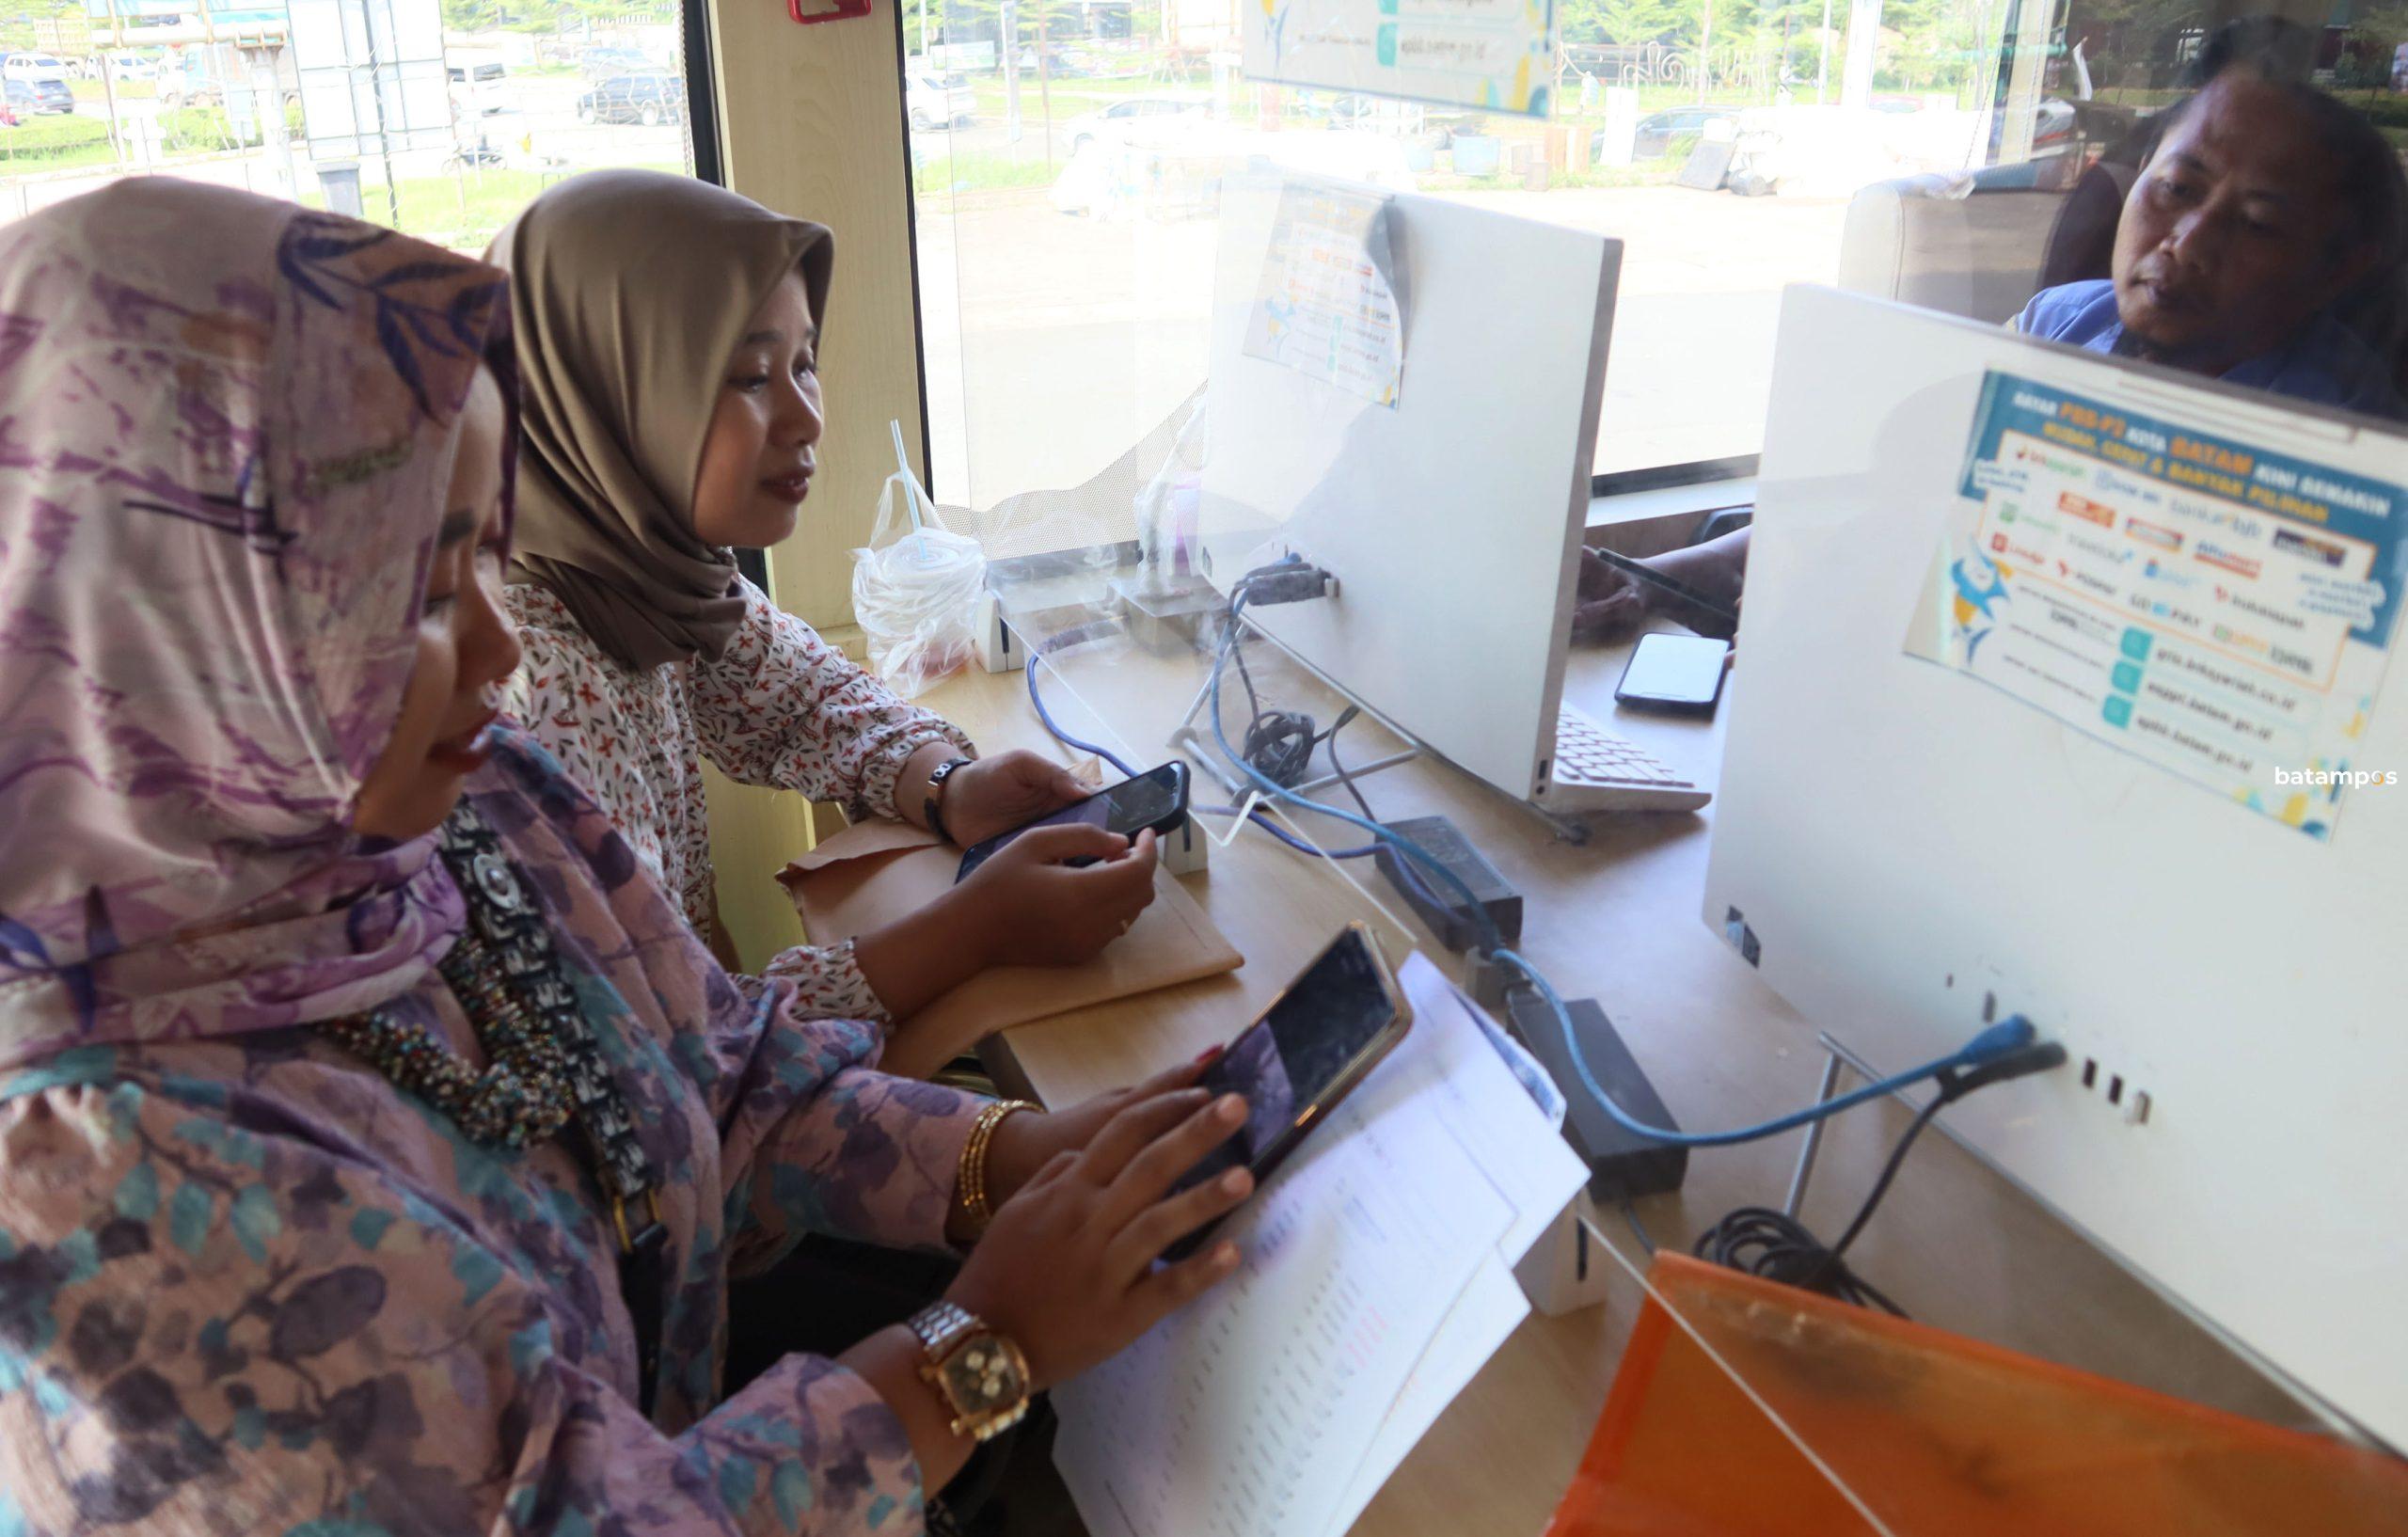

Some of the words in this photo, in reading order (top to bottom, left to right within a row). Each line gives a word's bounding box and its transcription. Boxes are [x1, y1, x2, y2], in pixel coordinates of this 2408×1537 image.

[2126, 427, 2166, 452] KOTA
[2171, 436, 2254, 476] BATAM
[2254, 463, 2298, 489] KINI
[2300, 475, 2392, 517] SEMAKIN
